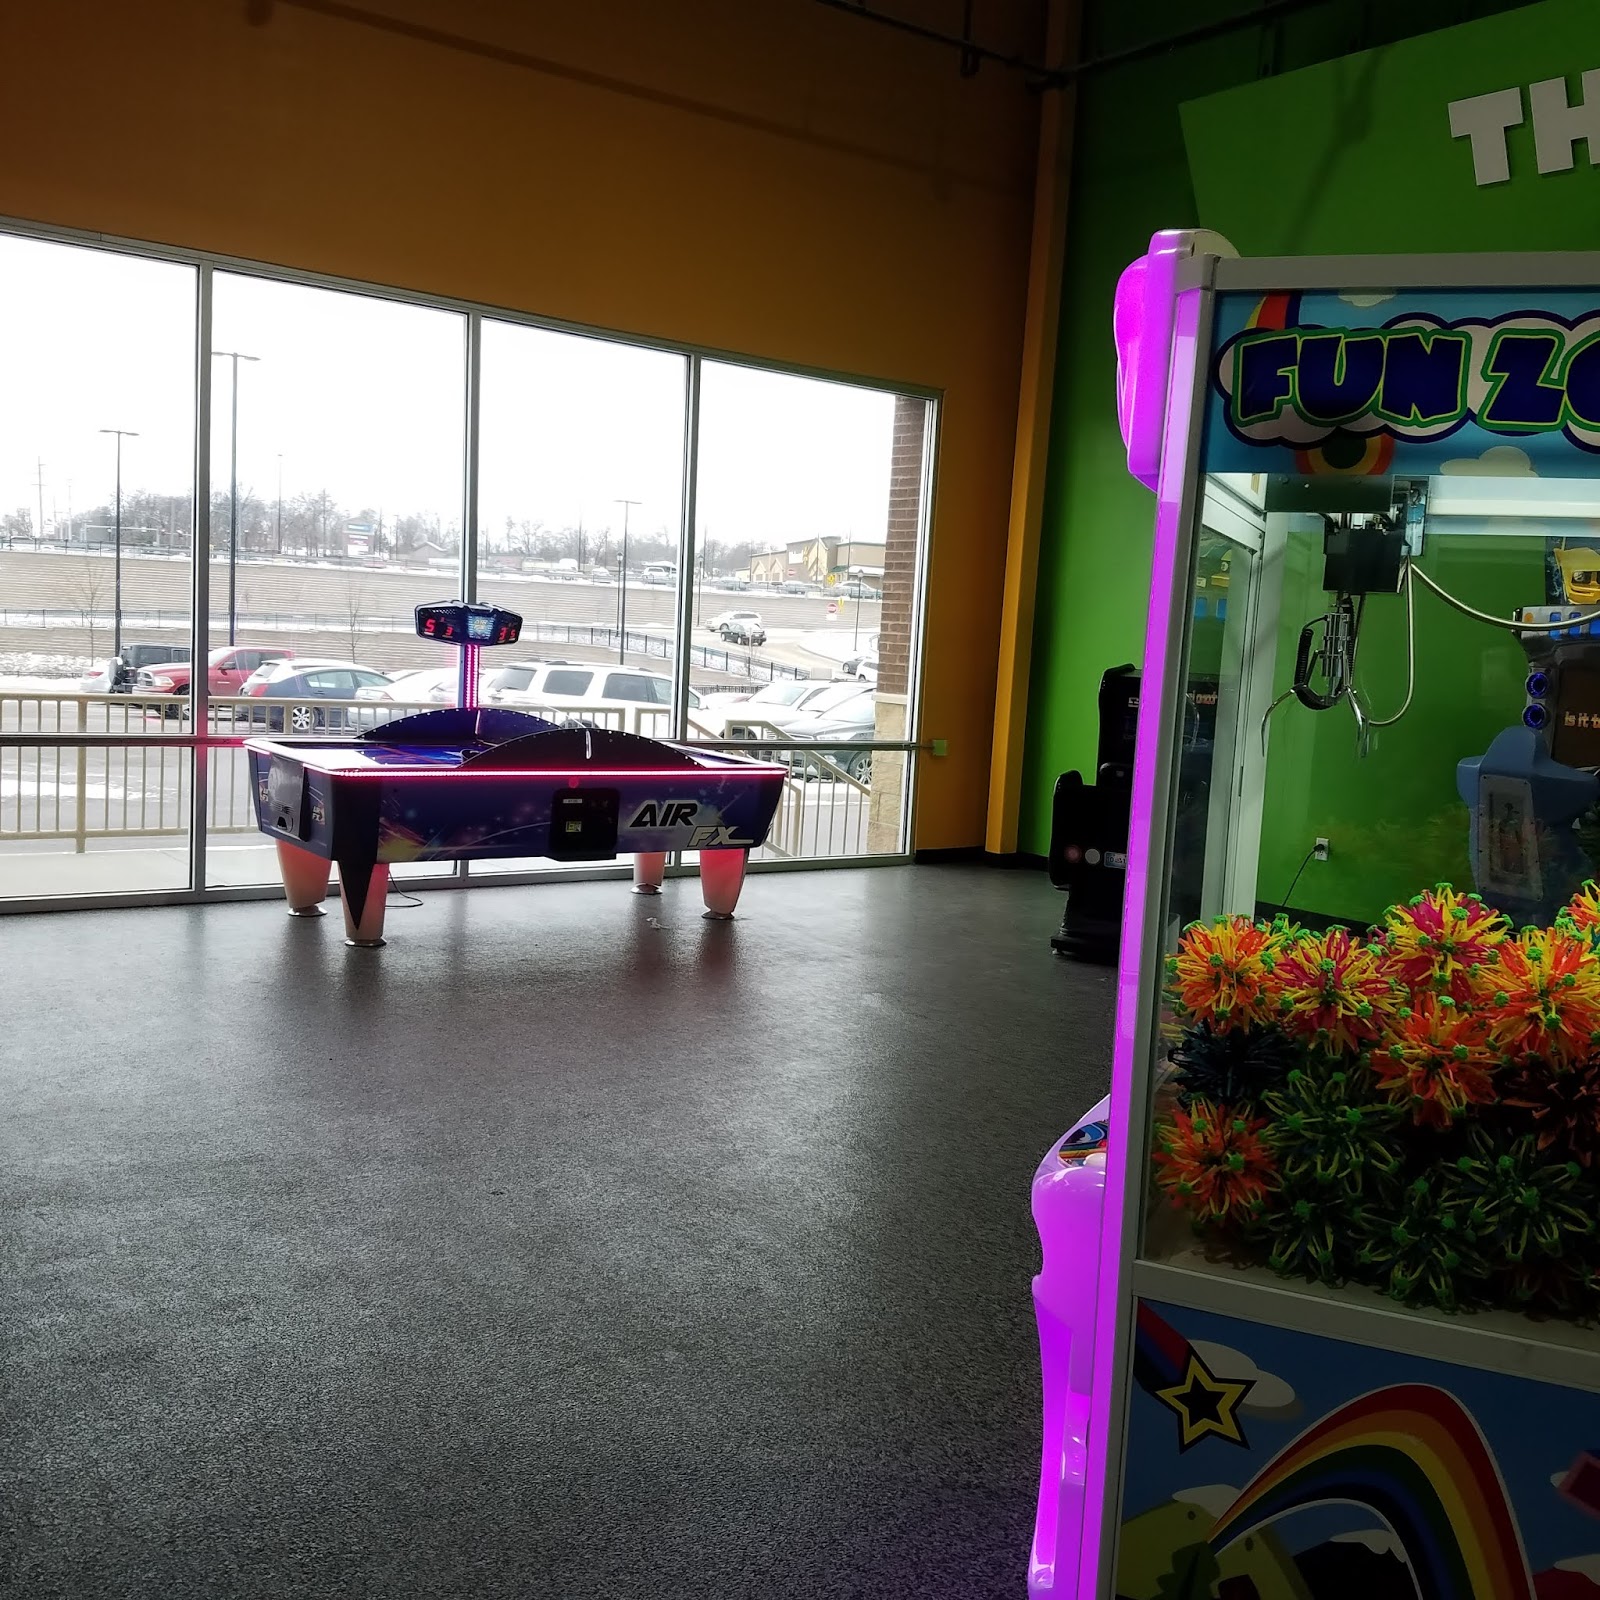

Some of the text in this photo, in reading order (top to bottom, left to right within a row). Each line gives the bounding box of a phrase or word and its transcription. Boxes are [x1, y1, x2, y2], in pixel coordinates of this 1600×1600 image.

[1235, 328, 1470, 426] FUN
[425, 618, 454, 636] 5 3
[630, 803, 698, 827] AIR
[687, 826, 755, 848] FX
